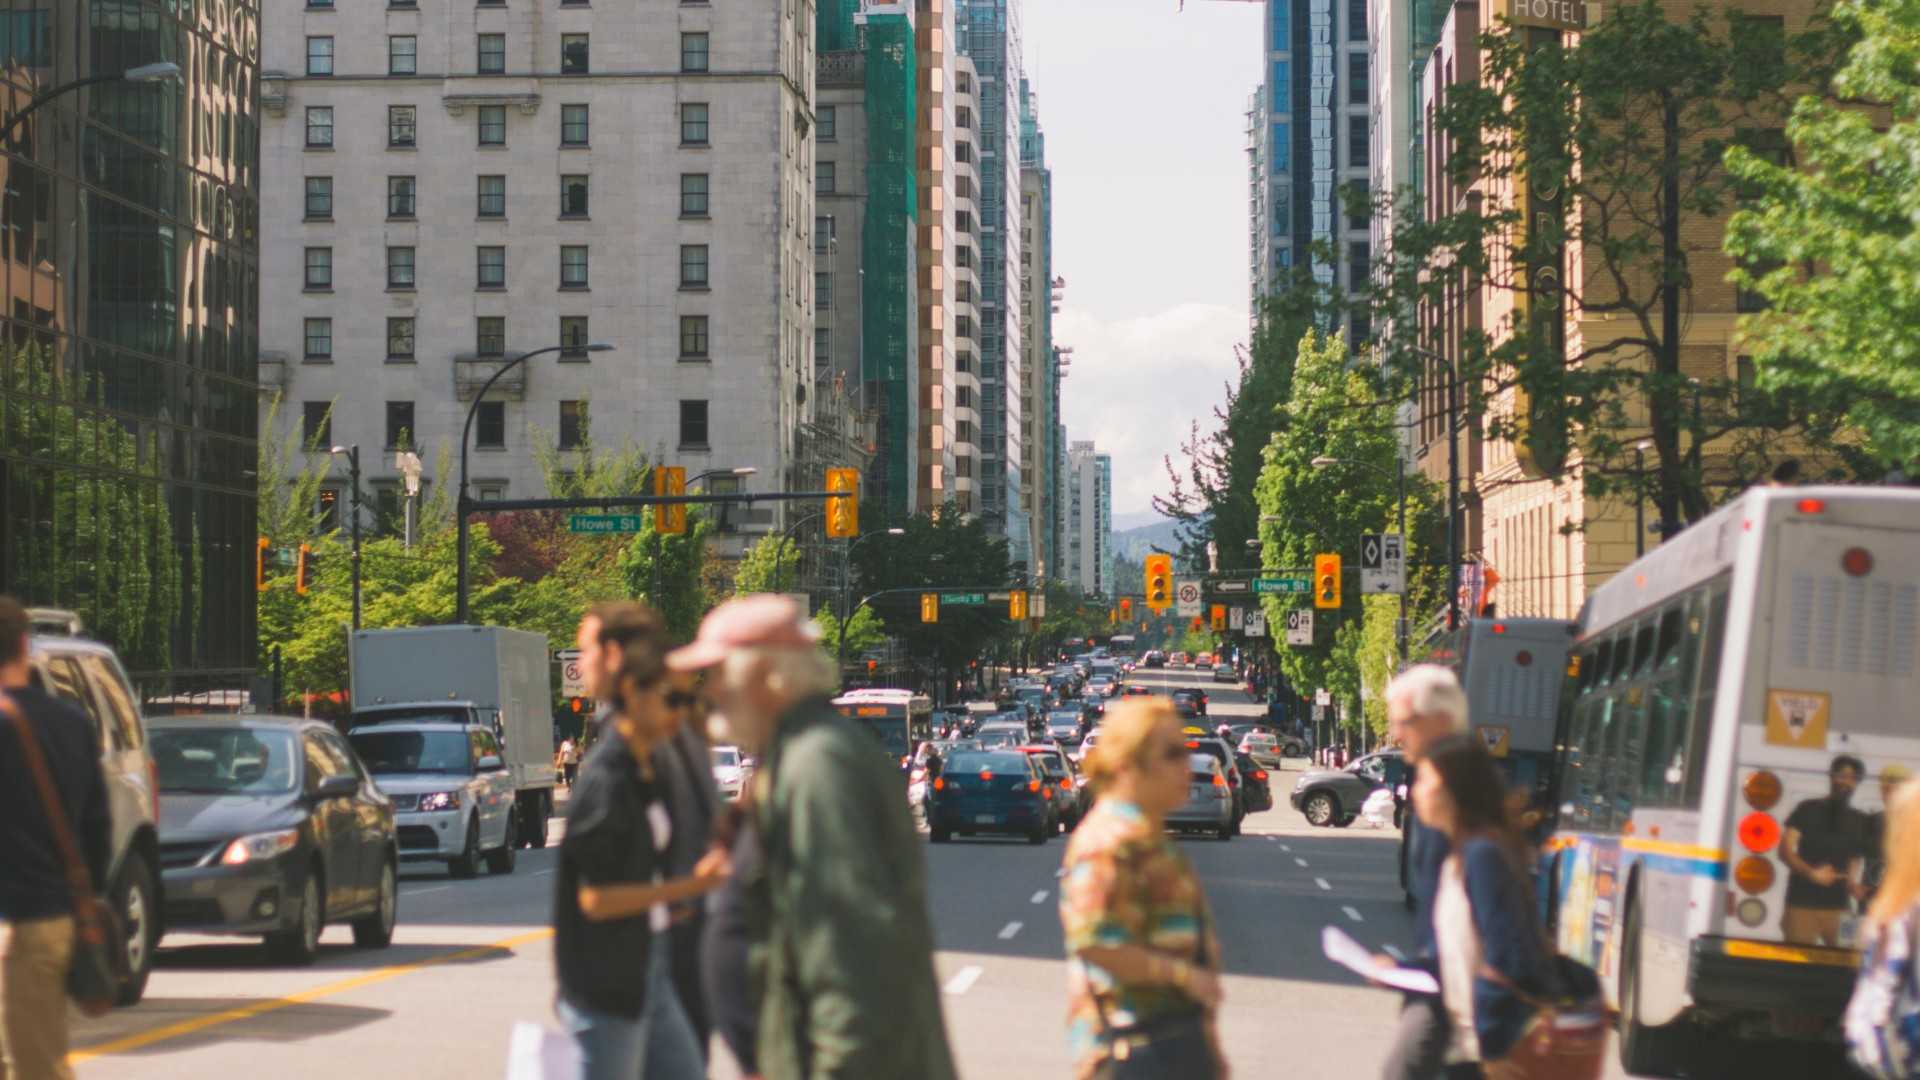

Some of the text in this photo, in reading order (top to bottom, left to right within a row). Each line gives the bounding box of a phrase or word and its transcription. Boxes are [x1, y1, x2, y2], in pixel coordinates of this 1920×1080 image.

[1514, 0, 1578, 24] HOTEL
[575, 518, 636, 530] Howe St
[1258, 580, 1305, 591] Howe St
